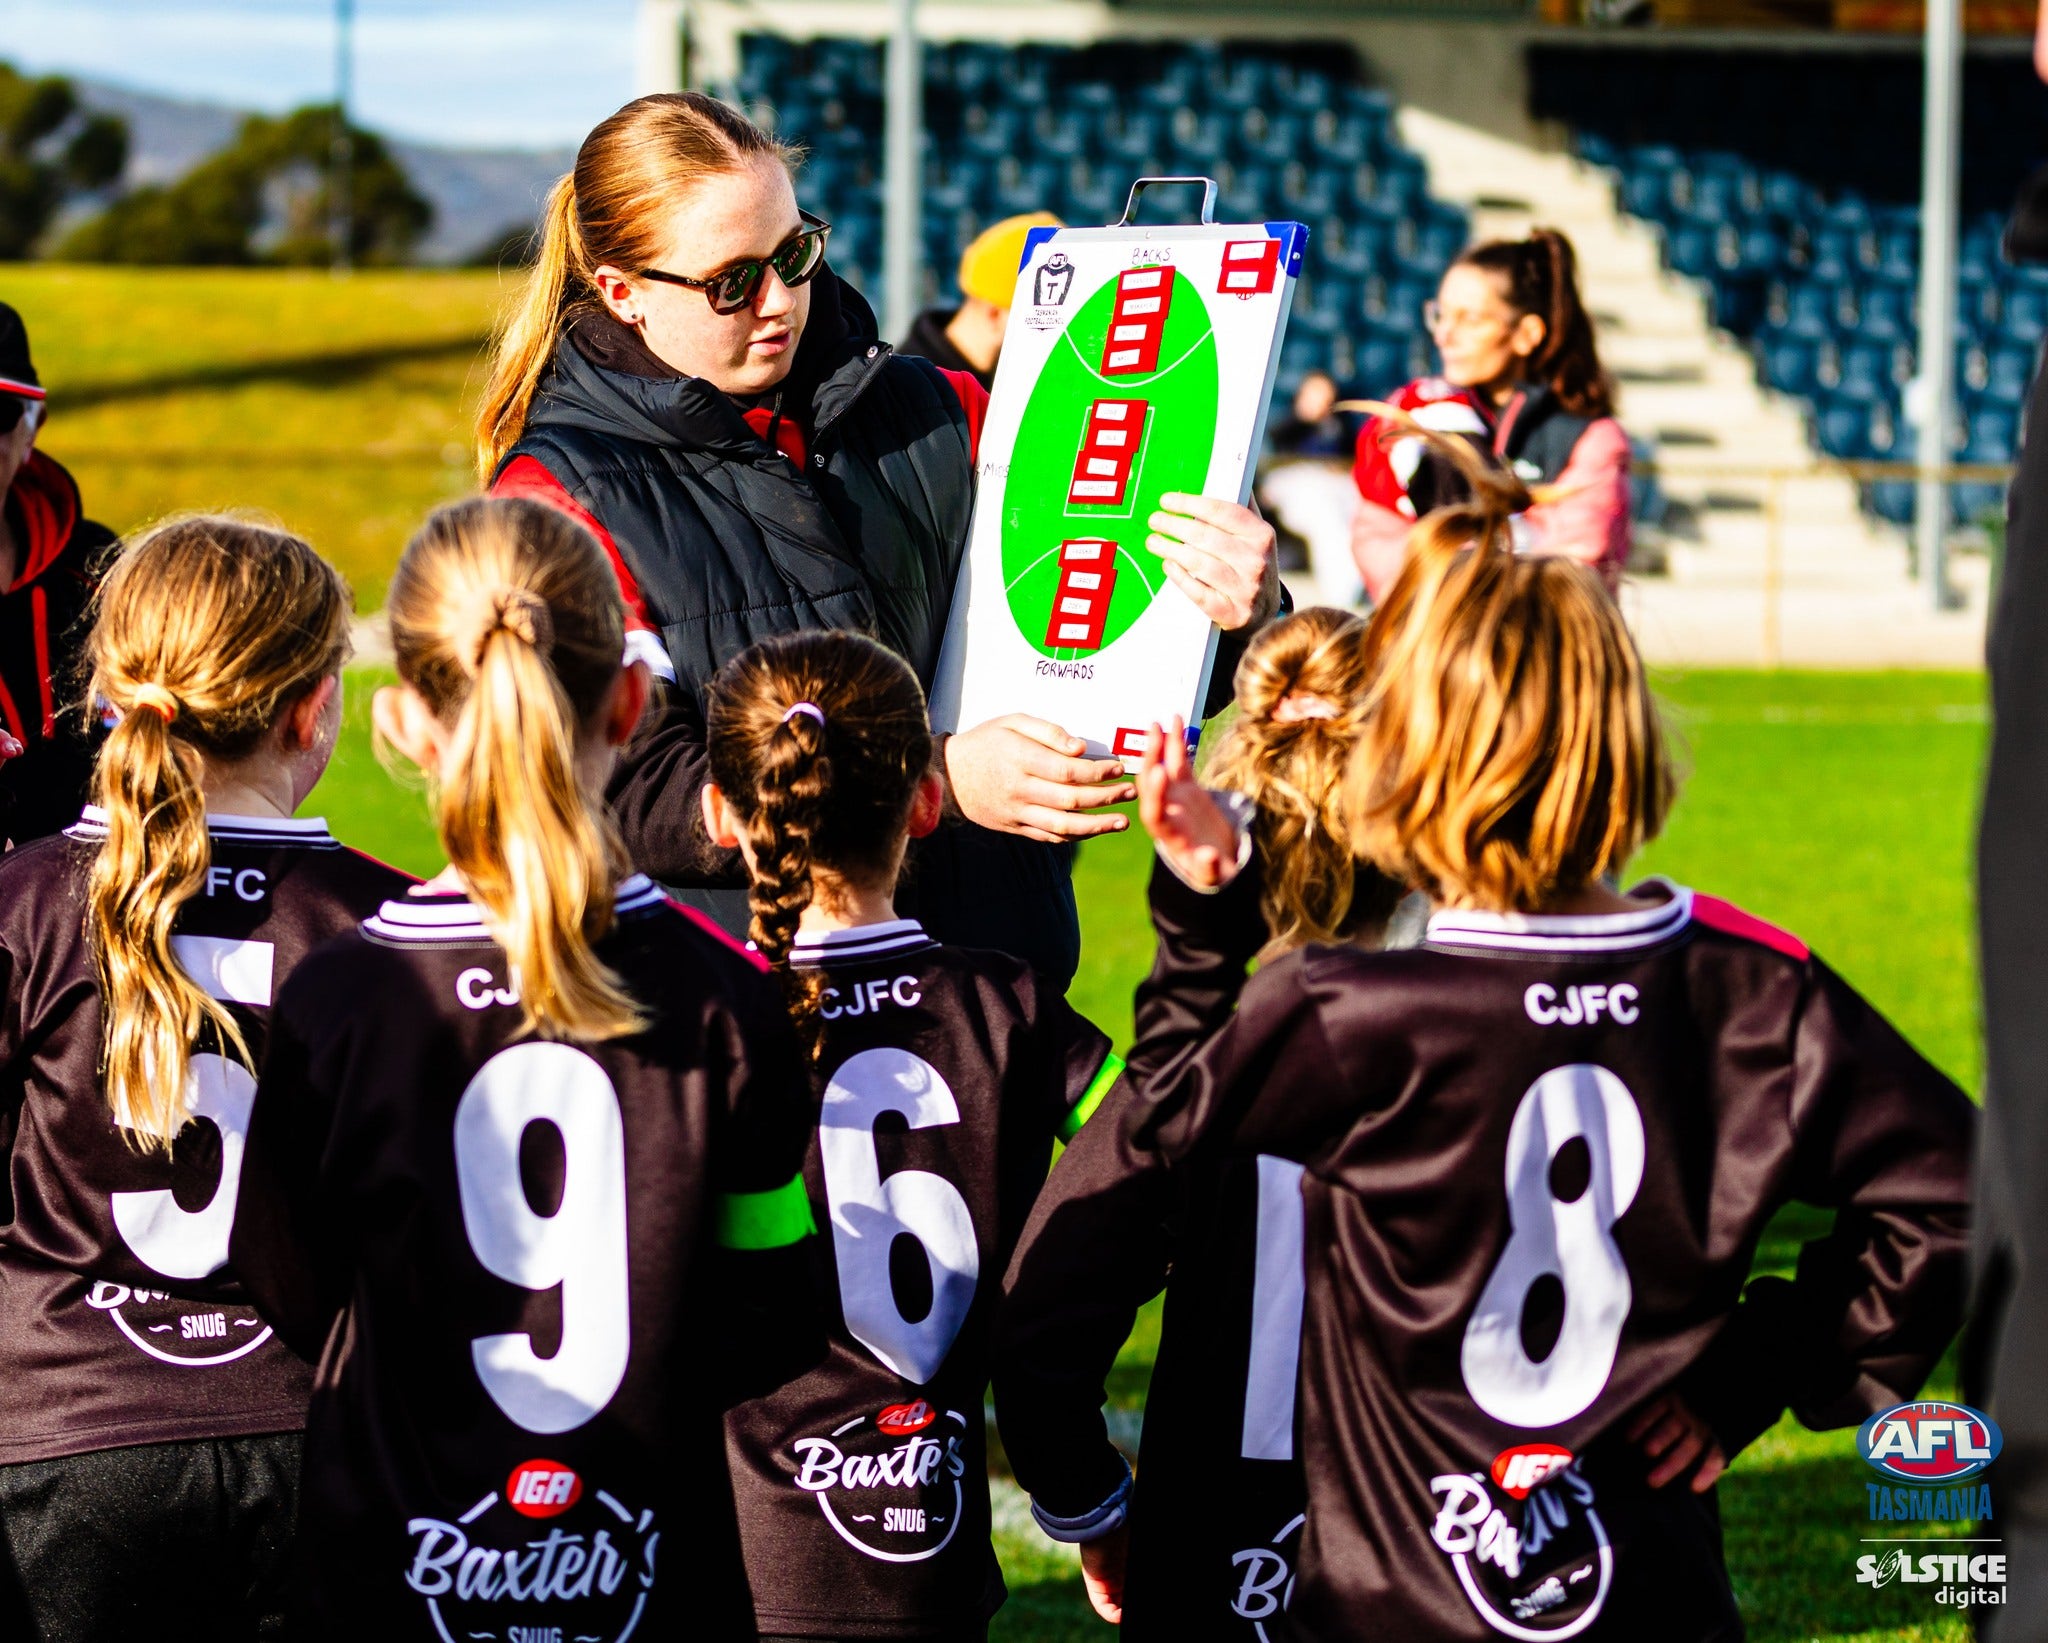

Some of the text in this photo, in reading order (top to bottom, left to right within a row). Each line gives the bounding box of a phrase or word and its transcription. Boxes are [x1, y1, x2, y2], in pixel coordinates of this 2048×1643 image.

[1132, 248, 1171, 265] BACKS
[1047, 283, 1058, 300] T
[1035, 660, 1095, 680] FORWARDS
[206, 867, 267, 902] FC
[456, 967, 524, 1010] CJ
[818, 975, 922, 1020] CJFC
[1524, 982, 1640, 1026] CJFC
[112, 935, 274, 1279] 5
[819, 1046, 980, 1385] 6
[454, 1041, 631, 1434] 9
[1461, 1063, 1646, 1429] 8
[181, 1313, 227, 1339] SNUG
[793, 1436, 965, 1491] Baxtes
[511, 1471, 576, 1505] IGA
[885, 1507, 926, 1533] SNUG
